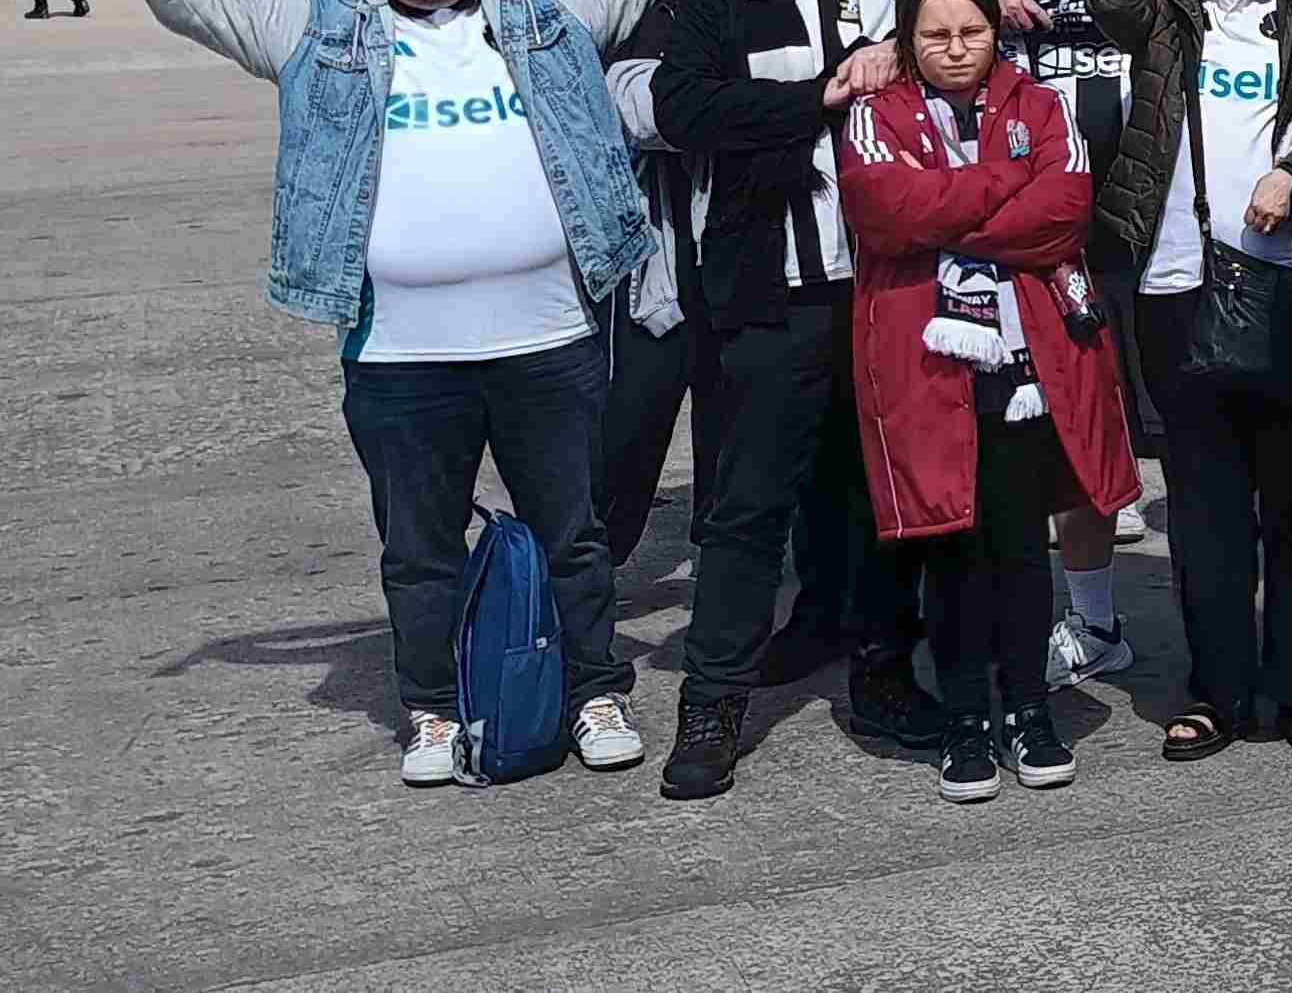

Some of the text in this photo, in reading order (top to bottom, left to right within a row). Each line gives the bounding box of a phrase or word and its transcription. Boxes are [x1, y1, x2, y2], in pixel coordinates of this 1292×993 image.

[1075, 45, 1122, 77] se
[1211, 62, 1281, 100] sel
[947, 297, 995, 320] LASS
